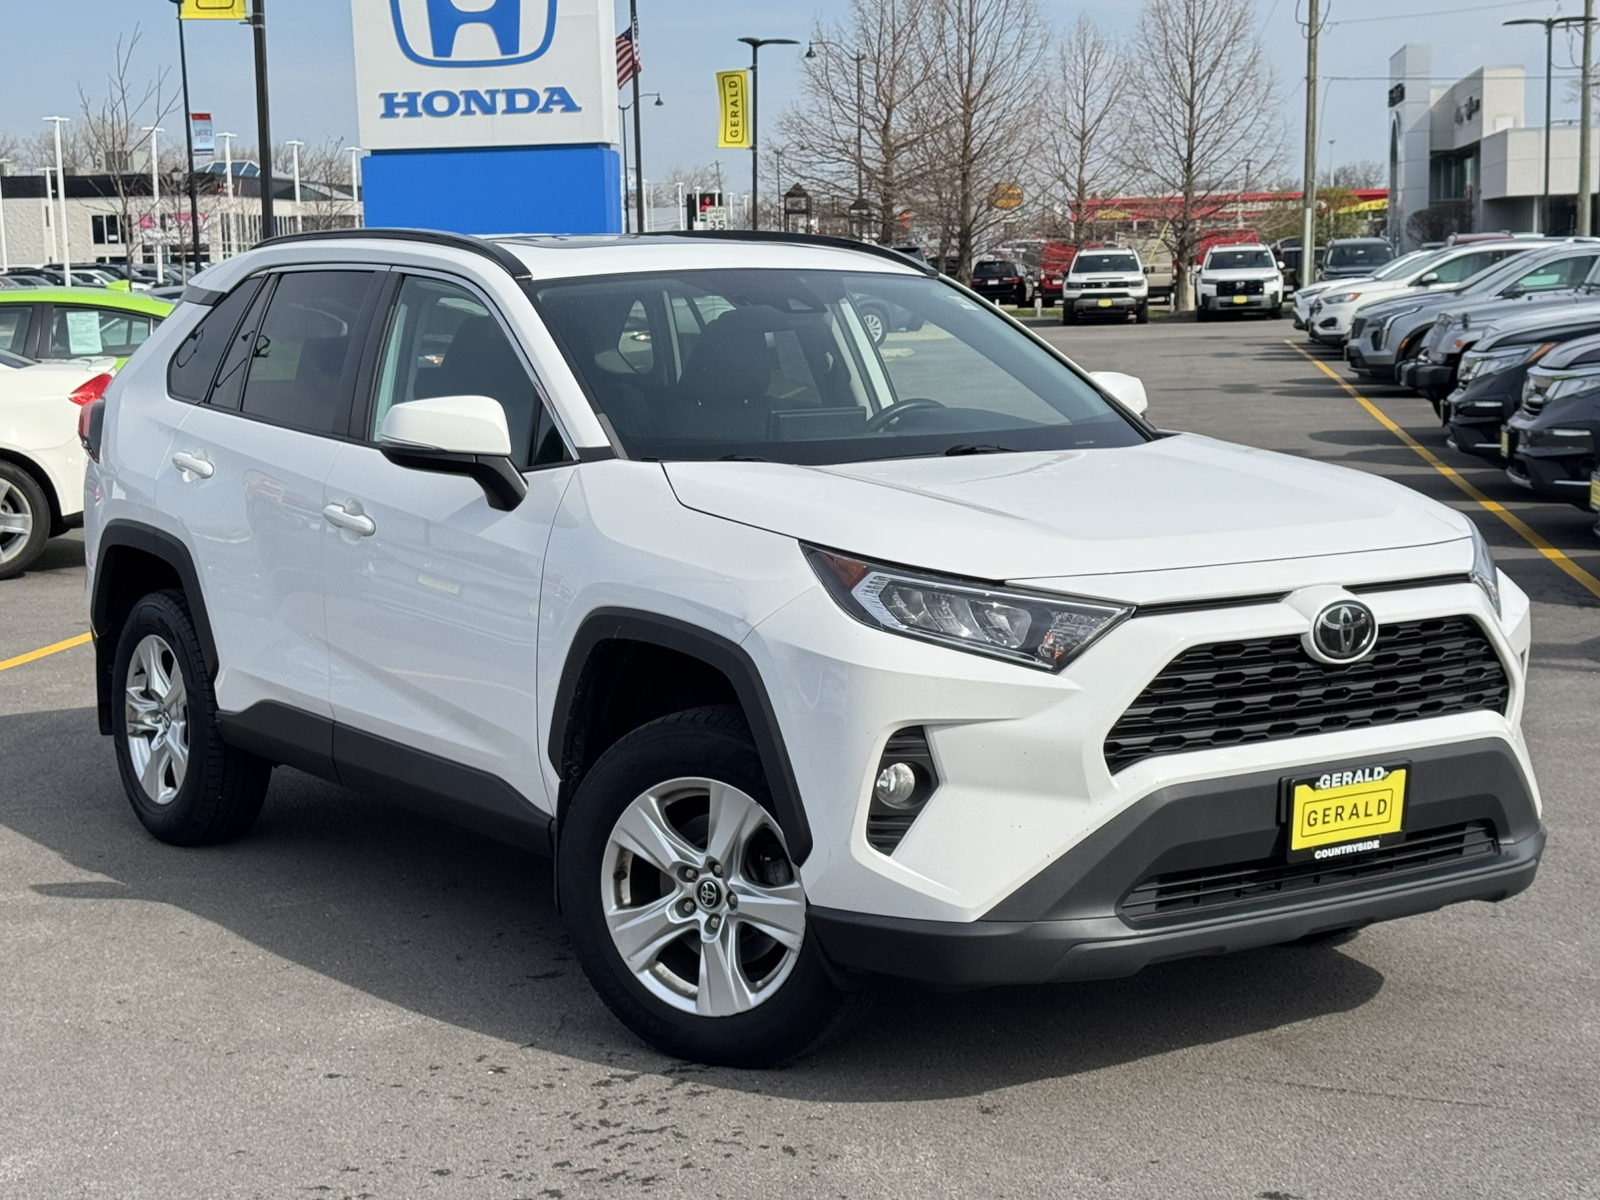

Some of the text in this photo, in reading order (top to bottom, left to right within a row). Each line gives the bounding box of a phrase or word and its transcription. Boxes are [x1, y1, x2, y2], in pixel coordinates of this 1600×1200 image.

[378, 86, 582, 119] HONDA
[728, 80, 740, 138] GERALD
[709, 219, 726, 230] 35
[1319, 766, 1385, 790] GERALD
[1306, 798, 1388, 827] GERALD
[1314, 839, 1380, 860] COUNTRYSIDE
